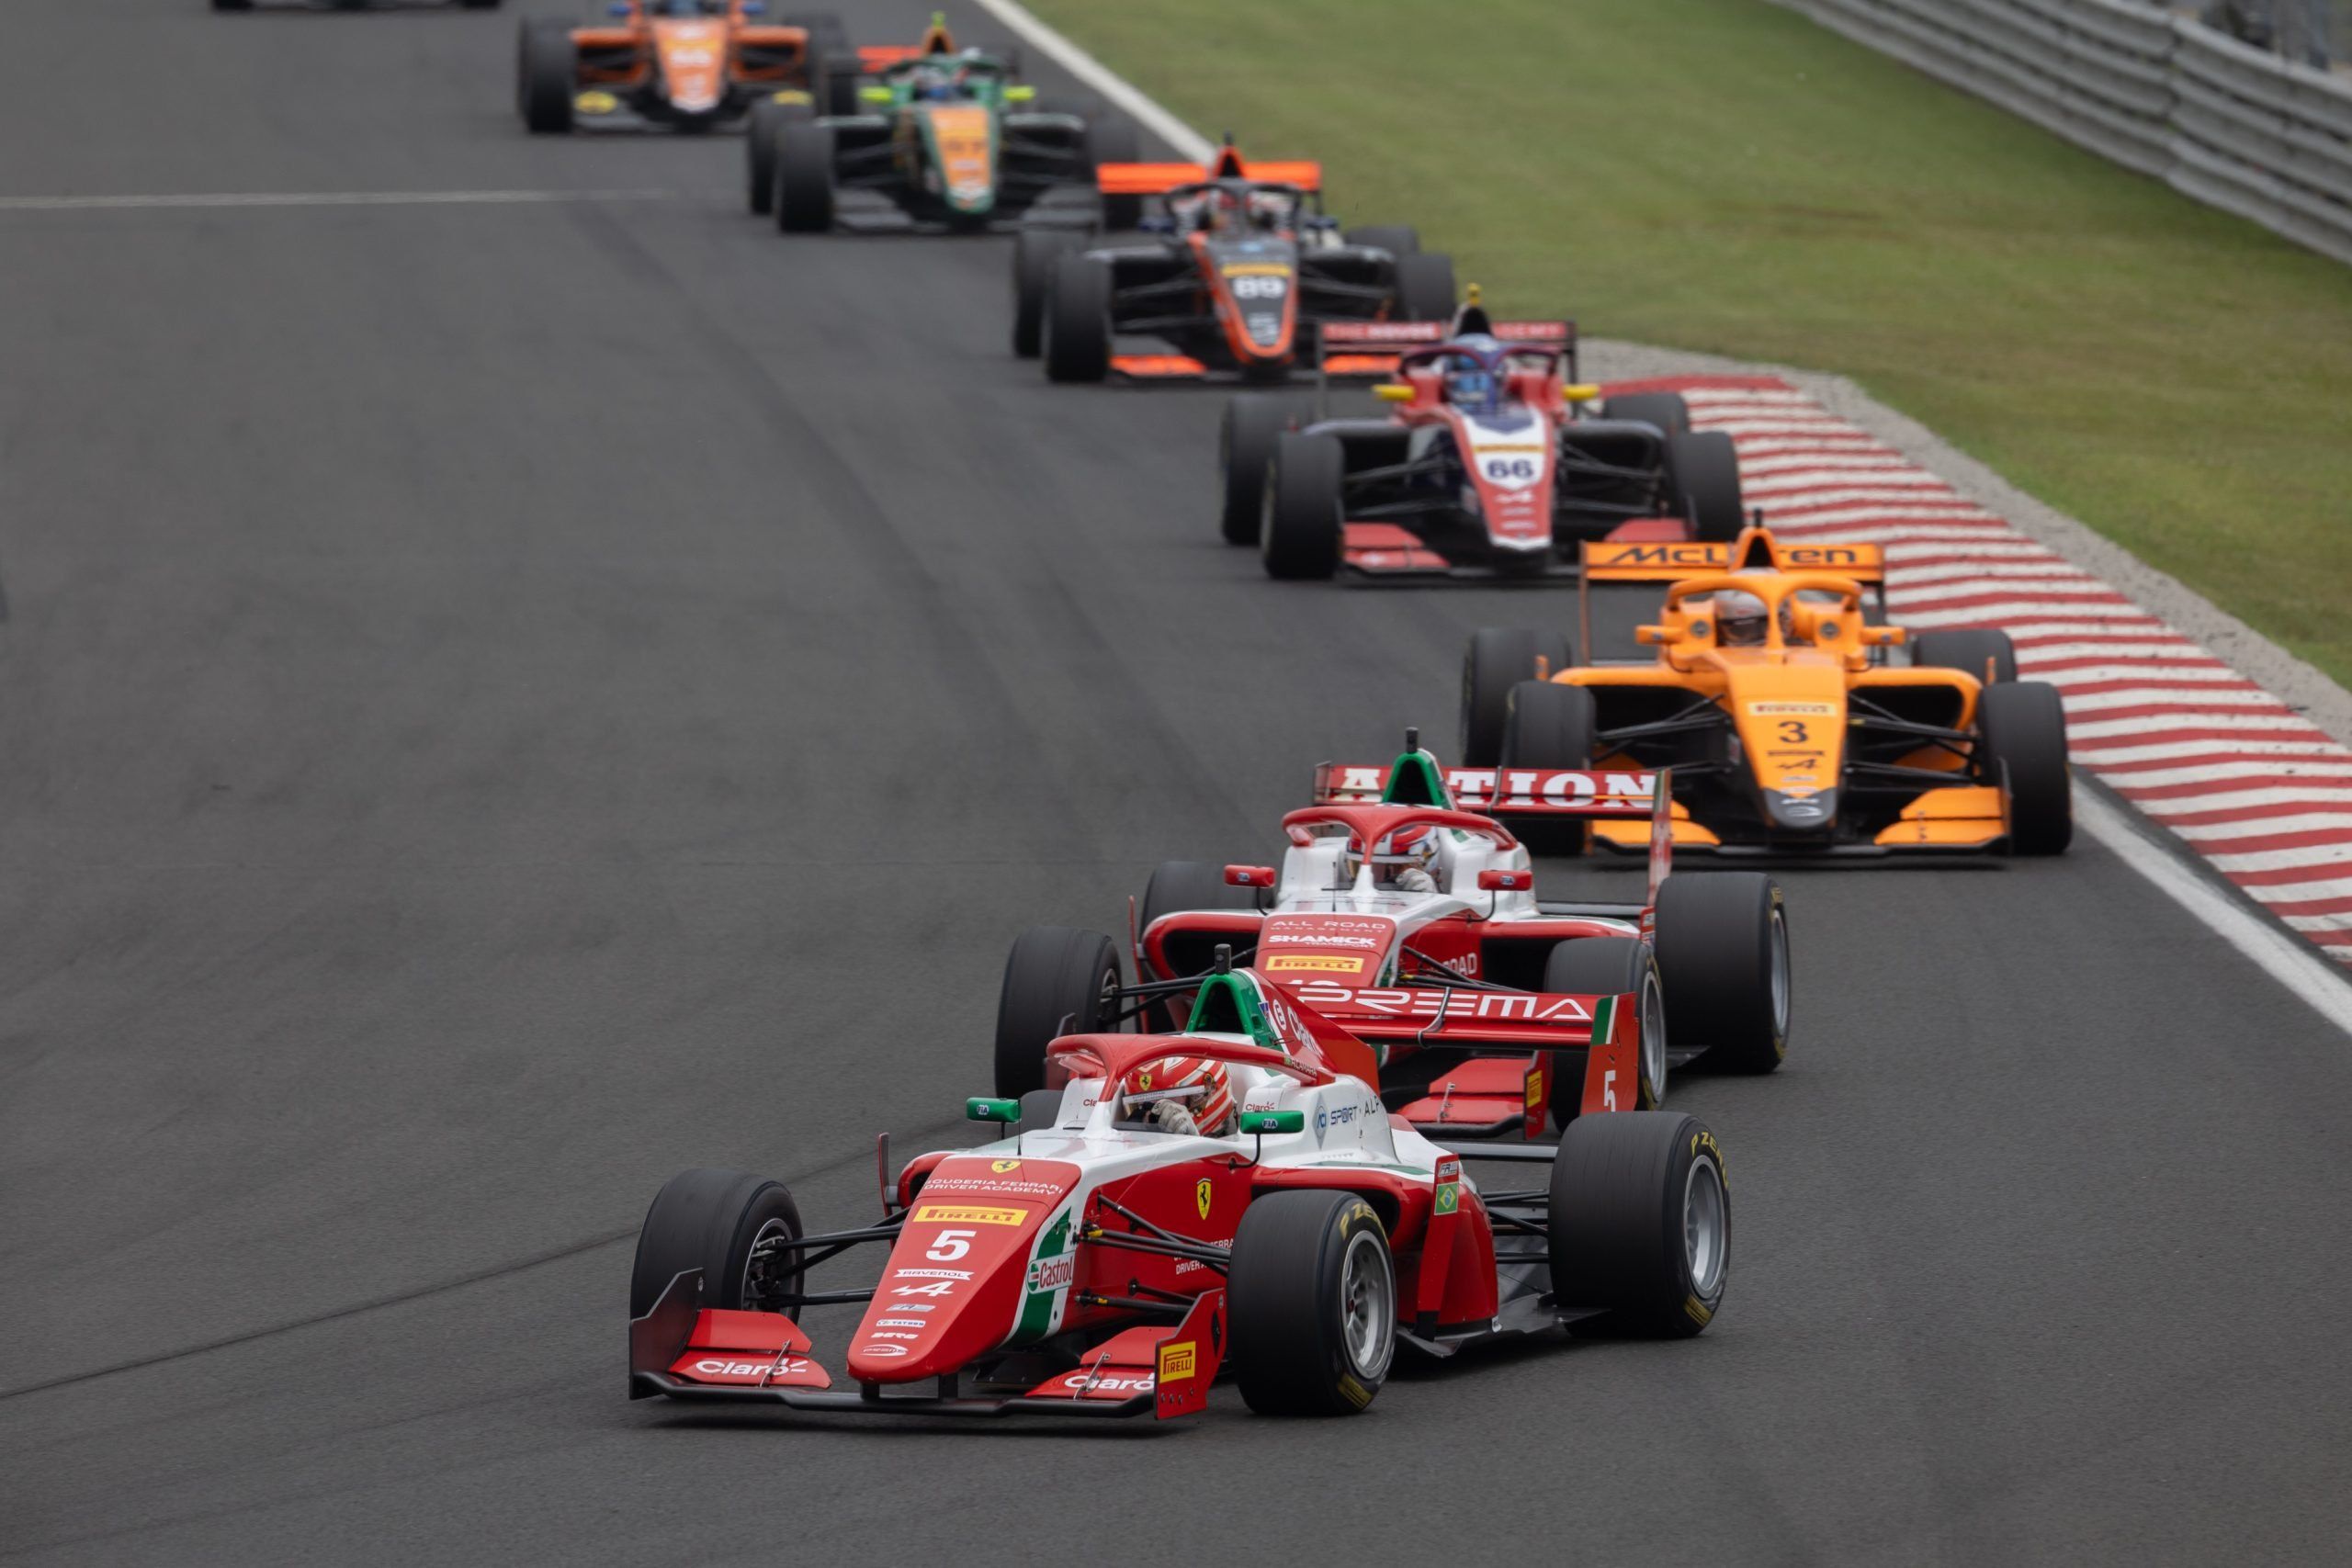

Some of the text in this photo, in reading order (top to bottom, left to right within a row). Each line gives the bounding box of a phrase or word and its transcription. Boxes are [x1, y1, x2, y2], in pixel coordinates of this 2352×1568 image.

[1487, 460, 1534, 478] 66
[1611, 547, 1856, 565] McLen
[1778, 721, 1808, 743] 3
[1334, 768, 1655, 808] ATION
[1324, 920, 1386, 930] ROAD
[1268, 934, 1377, 946] SHAMICK
[1273, 957, 1356, 970] PIRELLI
[1296, 987, 1592, 1021] PREMA
[1603, 1069, 1616, 1111] 5
[1083, 1099, 1097, 1107] Cla
[1245, 1102, 1271, 1111] Claro
[1330, 1106, 1358, 1125] SPORT
[1690, 1133, 1699, 1158] P
[981, 1184, 1057, 1196] ACADEMY
[1000, 1180, 1063, 1194] FERRARI
[925, 1208, 1016, 1223] PIRELLI
[926, 1230, 977, 1261] 5
[1039, 1256, 1073, 1289] Castrol
[695, 1359, 789, 1376] Claro
[1163, 1349, 1193, 1375] PIRELLI
